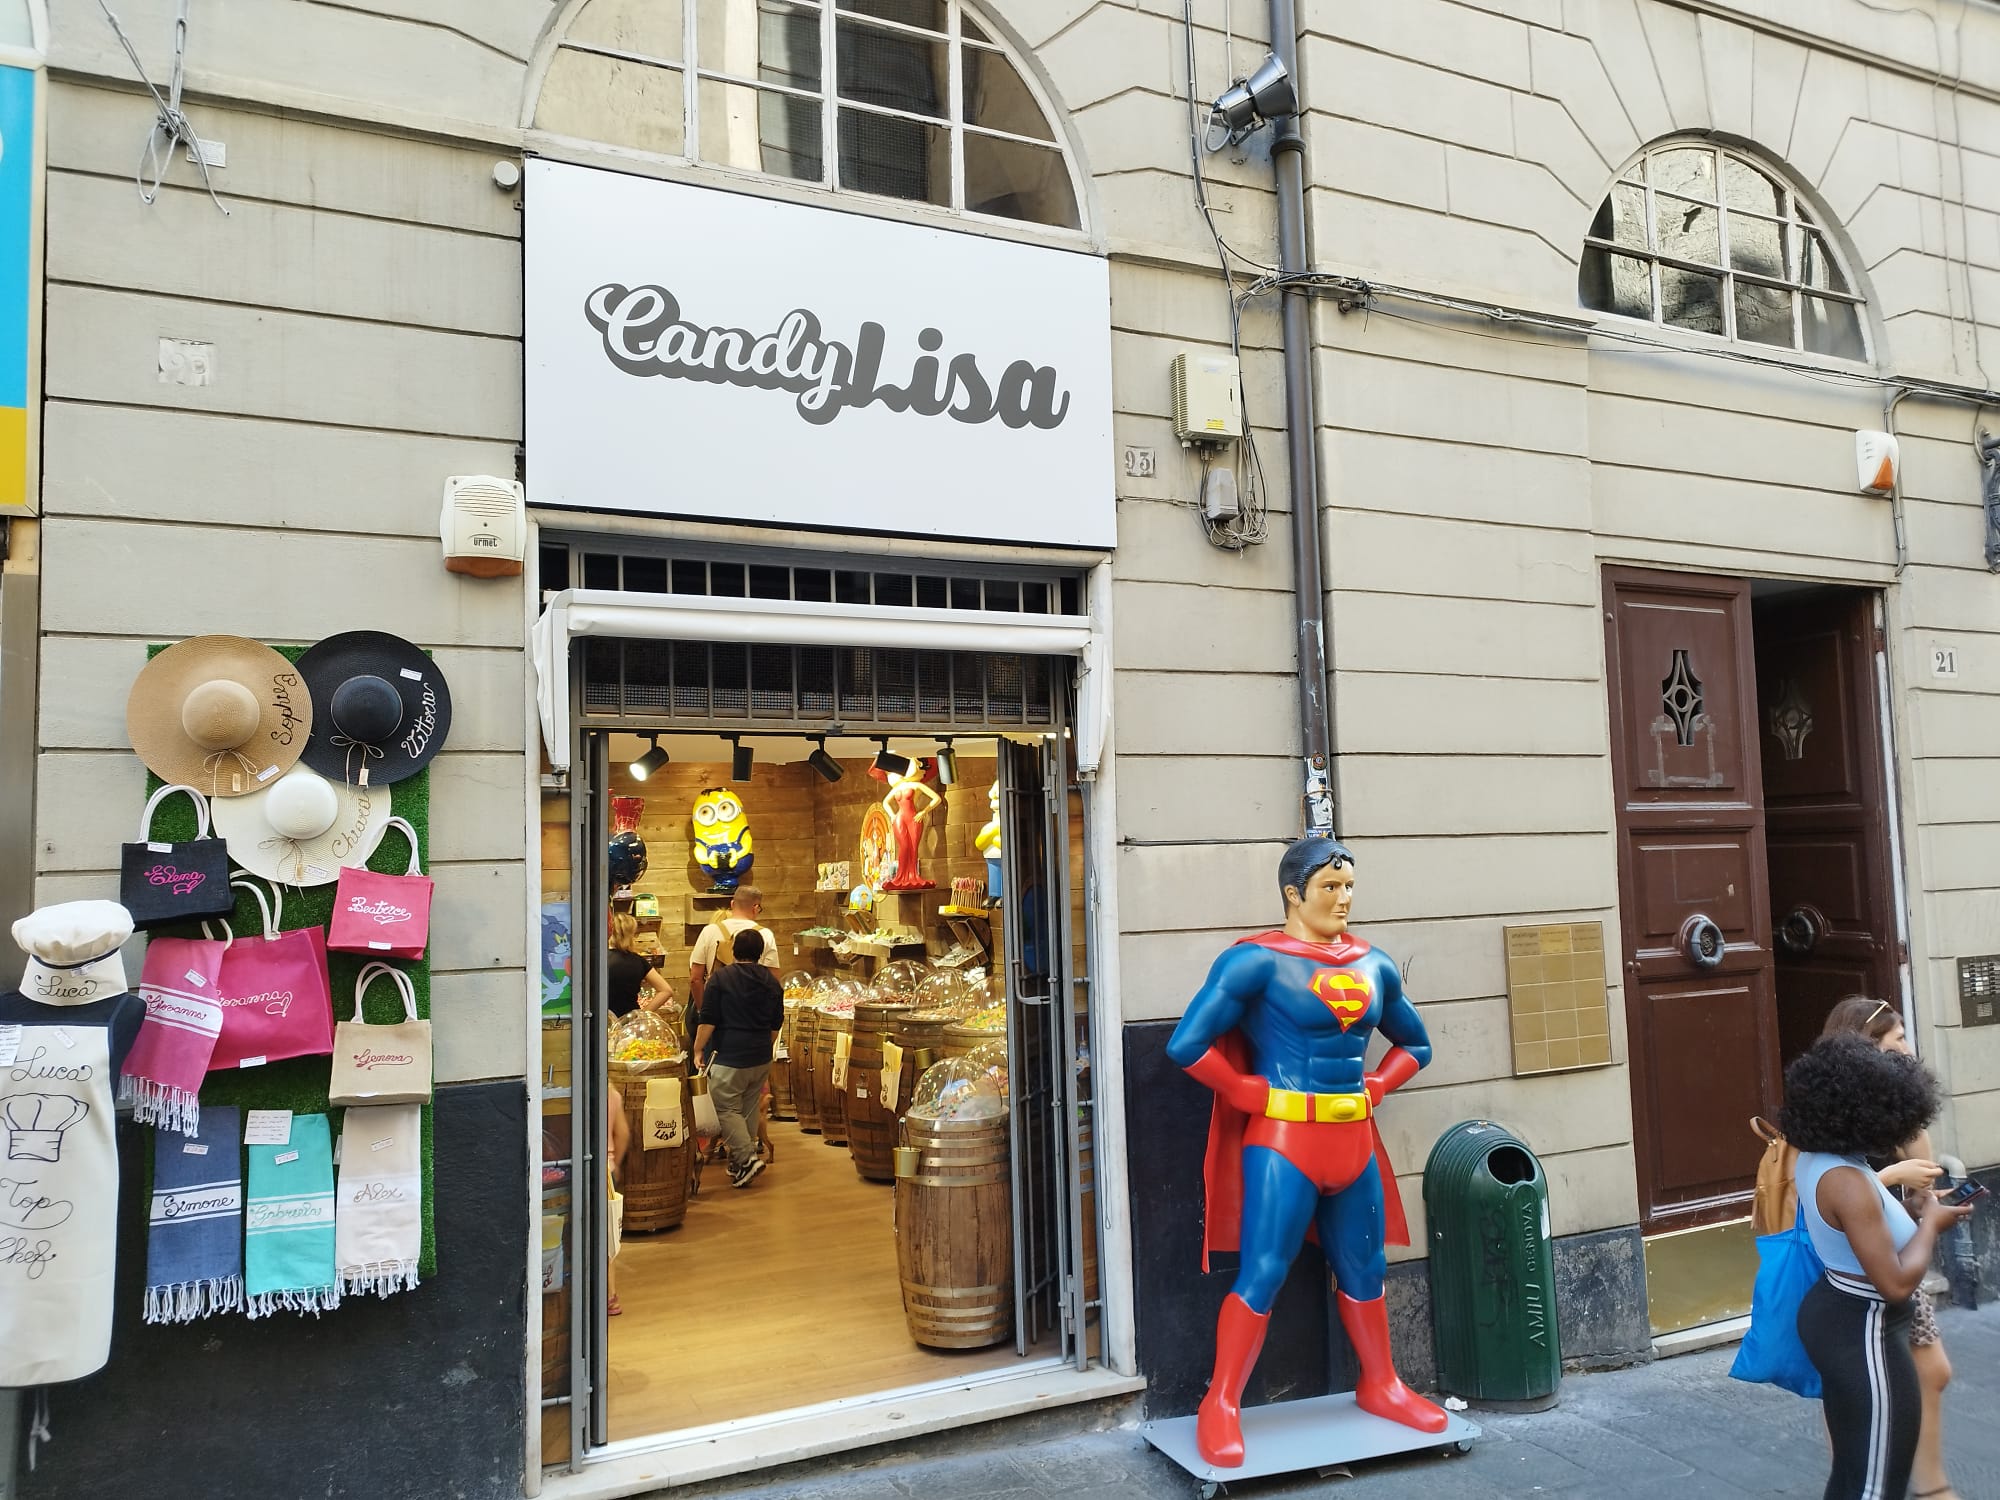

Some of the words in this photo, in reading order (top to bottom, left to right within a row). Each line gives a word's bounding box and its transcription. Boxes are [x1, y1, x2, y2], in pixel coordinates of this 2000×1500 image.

[473, 537, 498, 548] urmet
[1935, 652, 1956, 673] 21
[401, 682, 436, 759] Vittoria
[331, 789, 374, 859] Chiara
[347, 896, 413, 925] Beatrice
[35, 974, 97, 998] Luca
[10, 1046, 93, 1082] Luca
[353, 1049, 414, 1071] Genova
[654, 1129, 677, 1141] Lisa
[0, 1177, 74, 1231] Top
[353, 1182, 403, 1203] Alex
[163, 1195, 234, 1217] Simone
